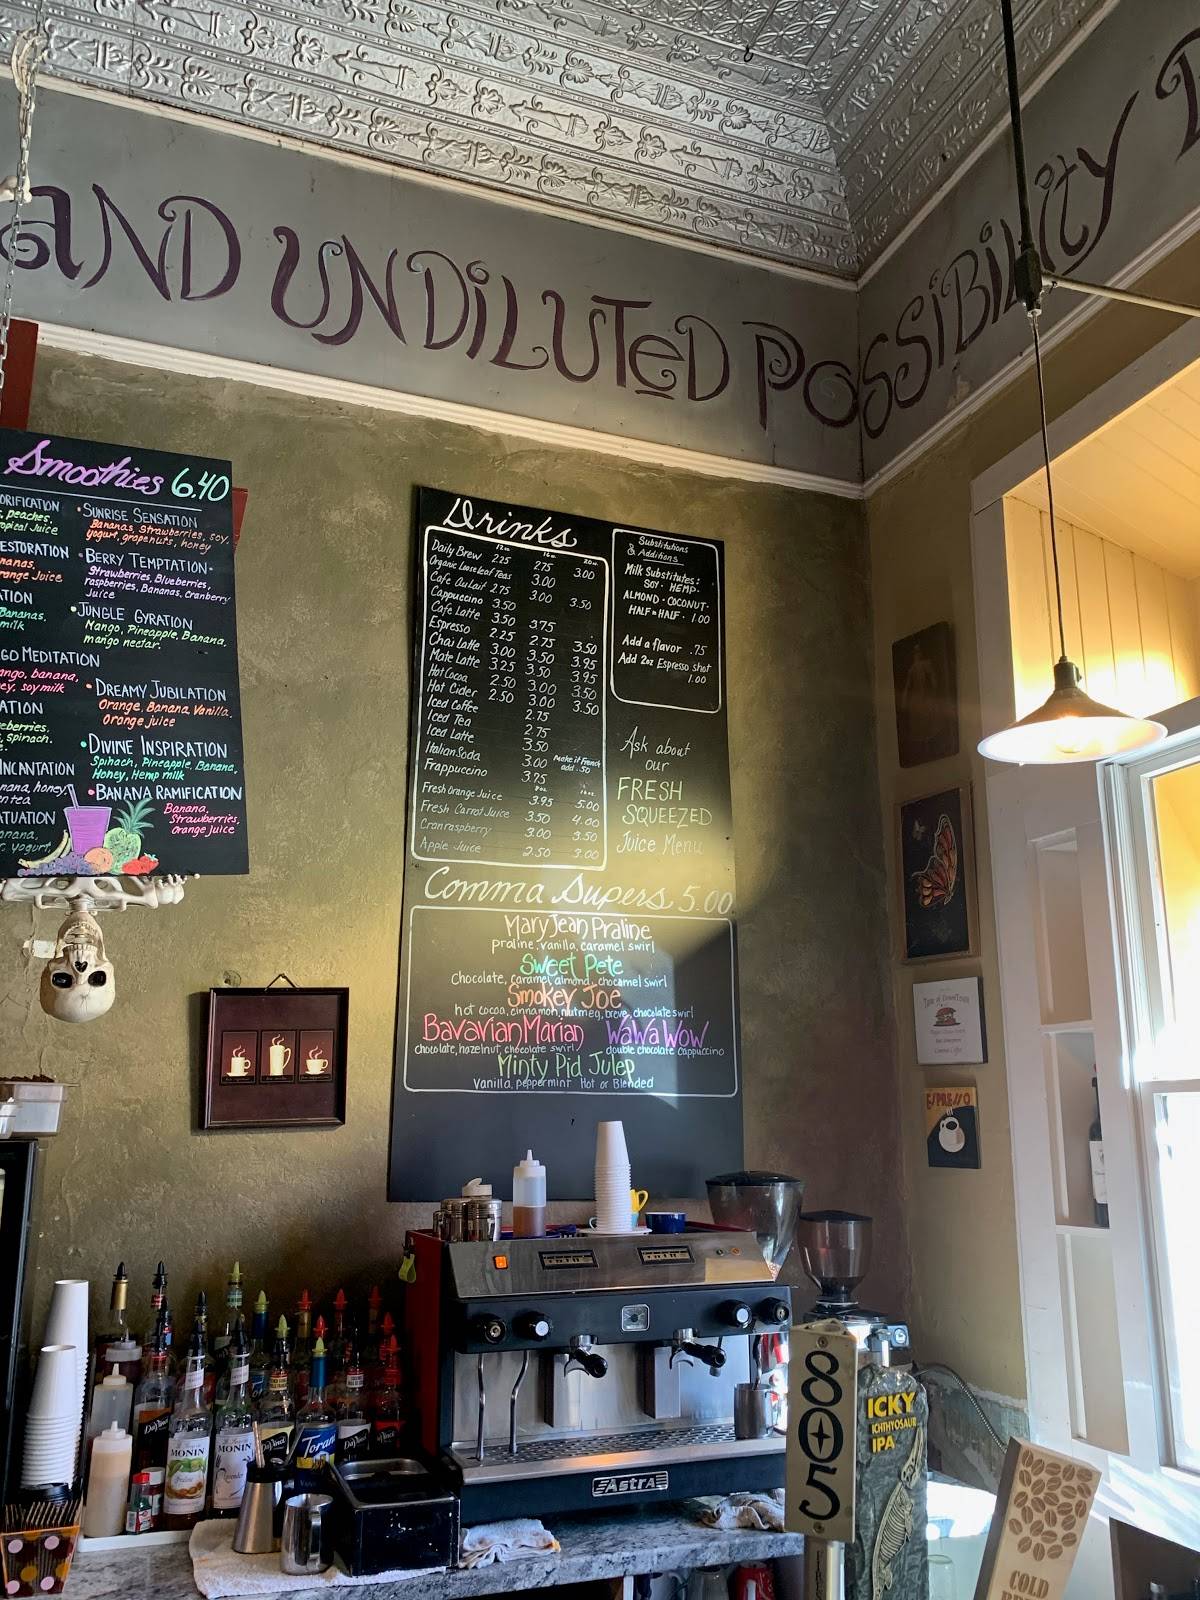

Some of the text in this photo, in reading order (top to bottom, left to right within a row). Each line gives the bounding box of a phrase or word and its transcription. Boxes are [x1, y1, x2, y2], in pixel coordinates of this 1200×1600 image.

[4, 440, 230, 501] Smoothies 6.40
[83, 503, 198, 528] SUNRISE SENSATION
[443, 498, 577, 548] Drinks
[181, 539, 212, 555] honey
[638, 536, 689, 553] Substitutions
[638, 549, 679, 563] Additions
[85, 548, 124, 568] BERRY
[431, 539, 595, 580] Daily Brew 2.25 3.00
[625, 563, 643, 576] Milk
[429, 555, 556, 588] Organic Teas 3.00
[184, 590, 231, 605] Cranberry
[431, 586, 517, 611] Cappuccino 3.50
[490, 583, 511, 595] 2.75
[529, 590, 553, 604] 3.00
[569, 598, 592, 611] 3.50
[77, 601, 193, 631] JUNGLE GYRATION
[455, 605, 481, 621] Latte
[491, 613, 516, 627] 3.50
[528, 619, 556, 633] 3.75
[83, 635, 119, 649] mango
[429, 616, 598, 655] Espresso 2.25 2.75 3.50
[622, 634, 642, 646] Add
[652, 638, 682, 653] flavor
[22, 646, 100, 668] MEDITATION
[429, 632, 598, 671] Chai Latte 3.00 3.50 3.95
[618, 652, 712, 673] Add Espresso shot
[430, 649, 598, 684] Mate Latte 3.25 3.50 3.95
[95, 678, 226, 701] DREAMY JUBILATION
[428, 664, 597, 700] Hot Cocoa 2.50 3.00 3.50
[427, 679, 599, 715] Hot Cider 2.50 3.00 3.50
[427, 694, 550, 721] Iced Coffee 2.75
[103, 714, 176, 731] Orange juice
[428, 709, 550, 738] Iced Tea 2.75
[88, 733, 228, 759] DIVINE INSPIRATION
[427, 725, 548, 752] Iced Latte 3.50
[620, 726, 690, 759] Ask about
[0, 760, 74, 776] INCANTATION
[424, 758, 547, 784] Frappuccino 3.75
[522, 755, 547, 768] 3.00
[645, 760, 669, 771] our
[131, 770, 185, 783] Hemp milk
[10, 795, 31, 805] tea
[95, 784, 242, 801] BANANA RAMIFICATION
[422, 782, 600, 812] Fresh Orange 5.00
[617, 777, 683, 800] FRESH
[420, 800, 449, 815] Fresh
[454, 804, 484, 817] Carrot
[525, 811, 550, 823] 3.50
[622, 804, 712, 828] SQUEEZED
[171, 825, 235, 836] Orange juice
[424, 866, 733, 915] Comma Supers 5.00
[592, 918, 652, 941] Praline
[628, 942, 655, 953] swirl
[520, 953, 624, 976] Sweet Pete
[644, 977, 667, 988] swirl
[508, 983, 621, 1011] Smokey Joe
[455, 1004, 693, 1018] hot chocolate swirl
[423, 1012, 522, 1048] Bavarian
[523, 1014, 584, 1050] Marian
[504, 1044, 574, 1054] chocolate swirl
[606, 1045, 724, 1058] double cappuccino
[498, 1051, 635, 1082] Minty Pid Julep
[516, 1077, 653, 1089] peppermint or Blended
[867, 1392, 916, 1419] ICKY
[798, 1350, 843, 1521] 805
[872, 1417, 917, 1435] ICHTHYOSAUR
[170, 1448, 204, 1457] MONIN
[218, 1443, 252, 1453] MONIN
[872, 1437, 896, 1453] IPA
[1009, 1570, 1049, 1599] COLD
